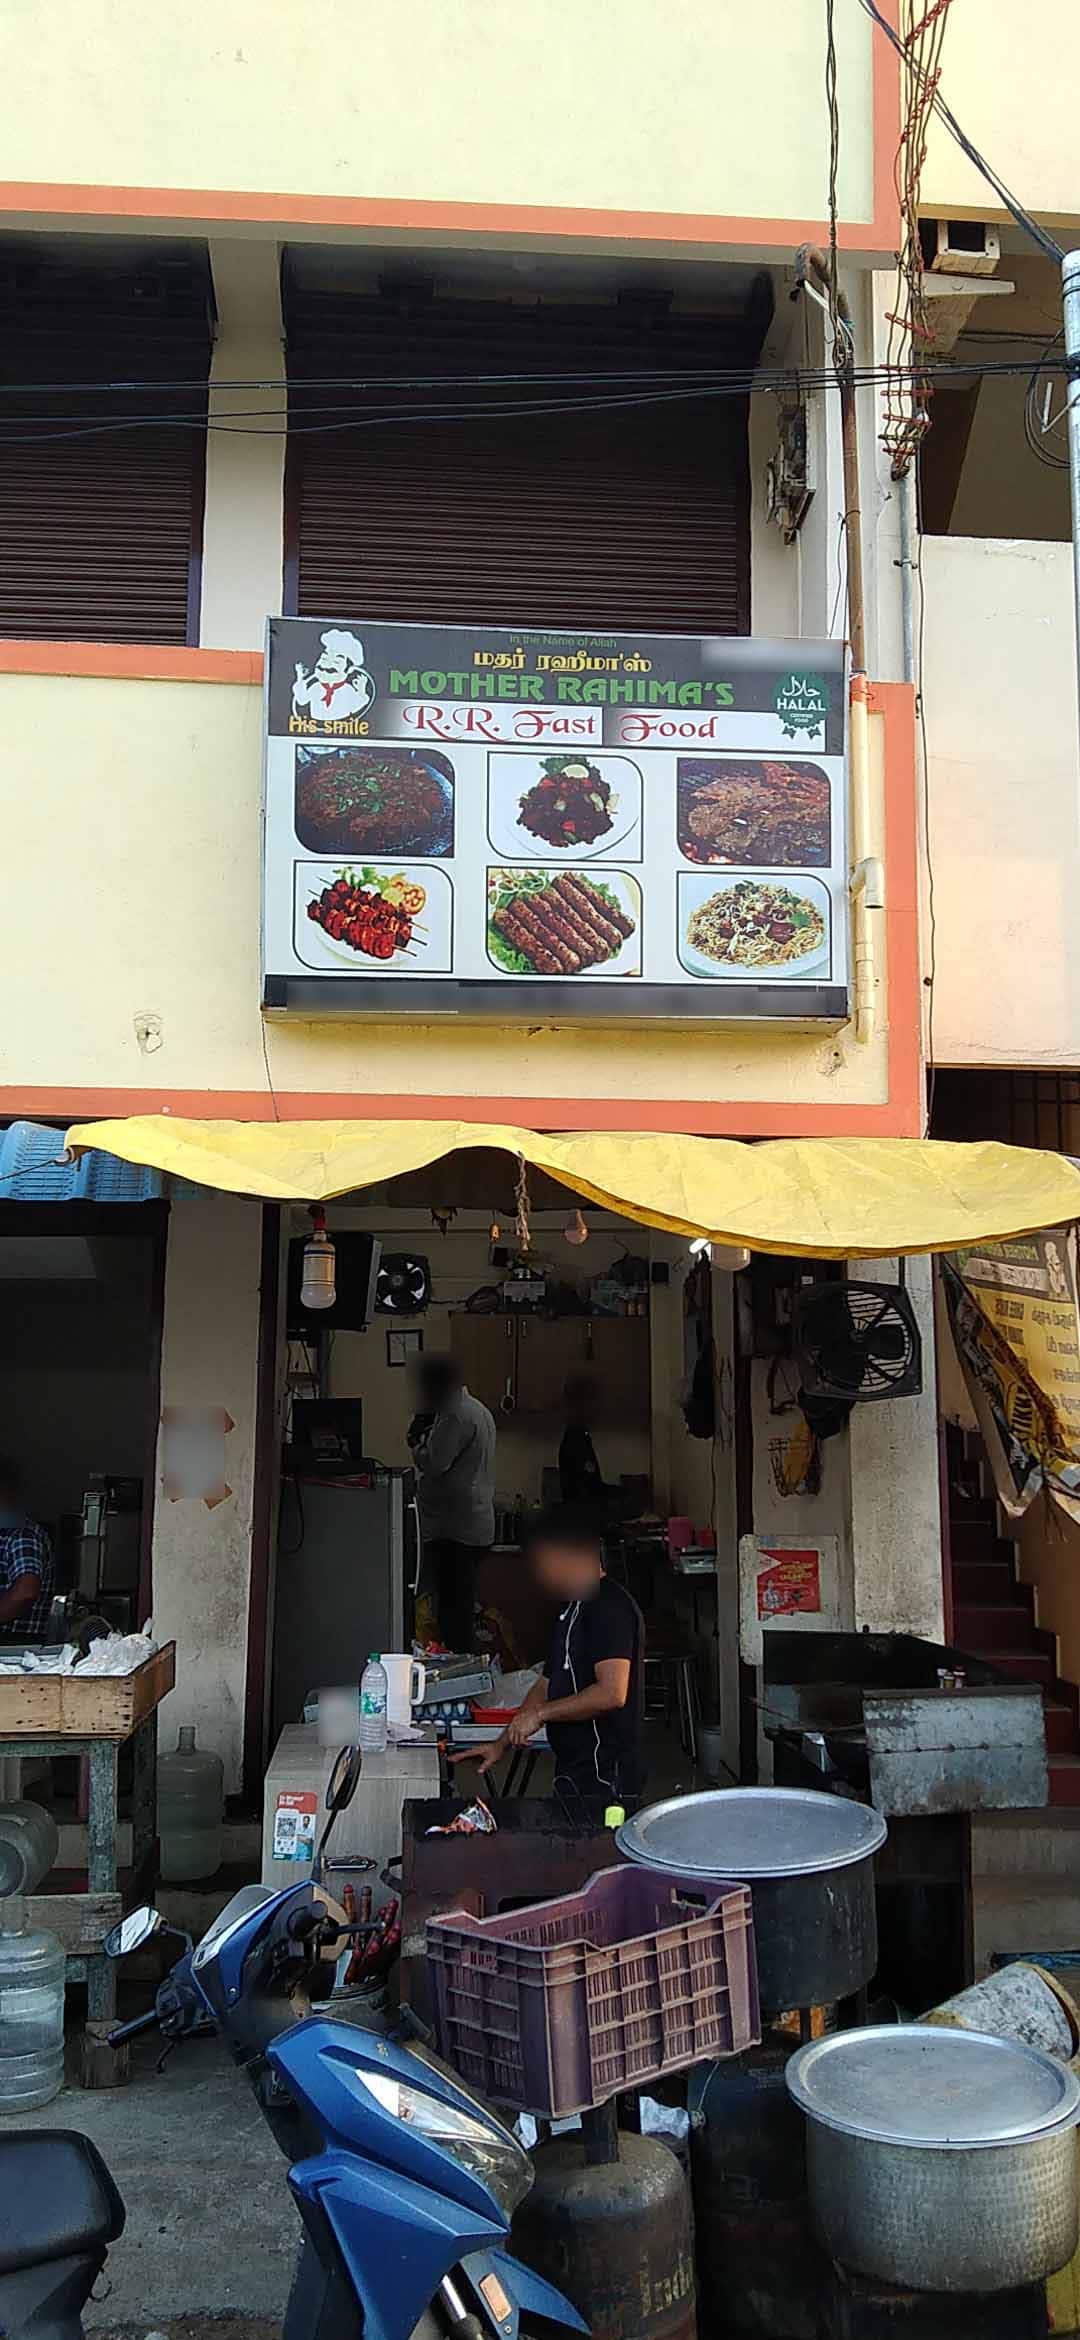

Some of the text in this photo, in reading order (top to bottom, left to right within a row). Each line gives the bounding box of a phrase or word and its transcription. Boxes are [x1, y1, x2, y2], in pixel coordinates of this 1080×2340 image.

[510, 635, 617, 649] In the Name of Allah
[473, 647, 527, 671] மதர்
[389, 669, 735, 706] MOTHER RAHIMA'S
[782, 675, 821, 697] حلال
[776, 697, 827, 712] HALAL
[288, 714, 369, 736] His smile
[512, 709, 596, 738] Fast
[620, 712, 719, 743] Food
